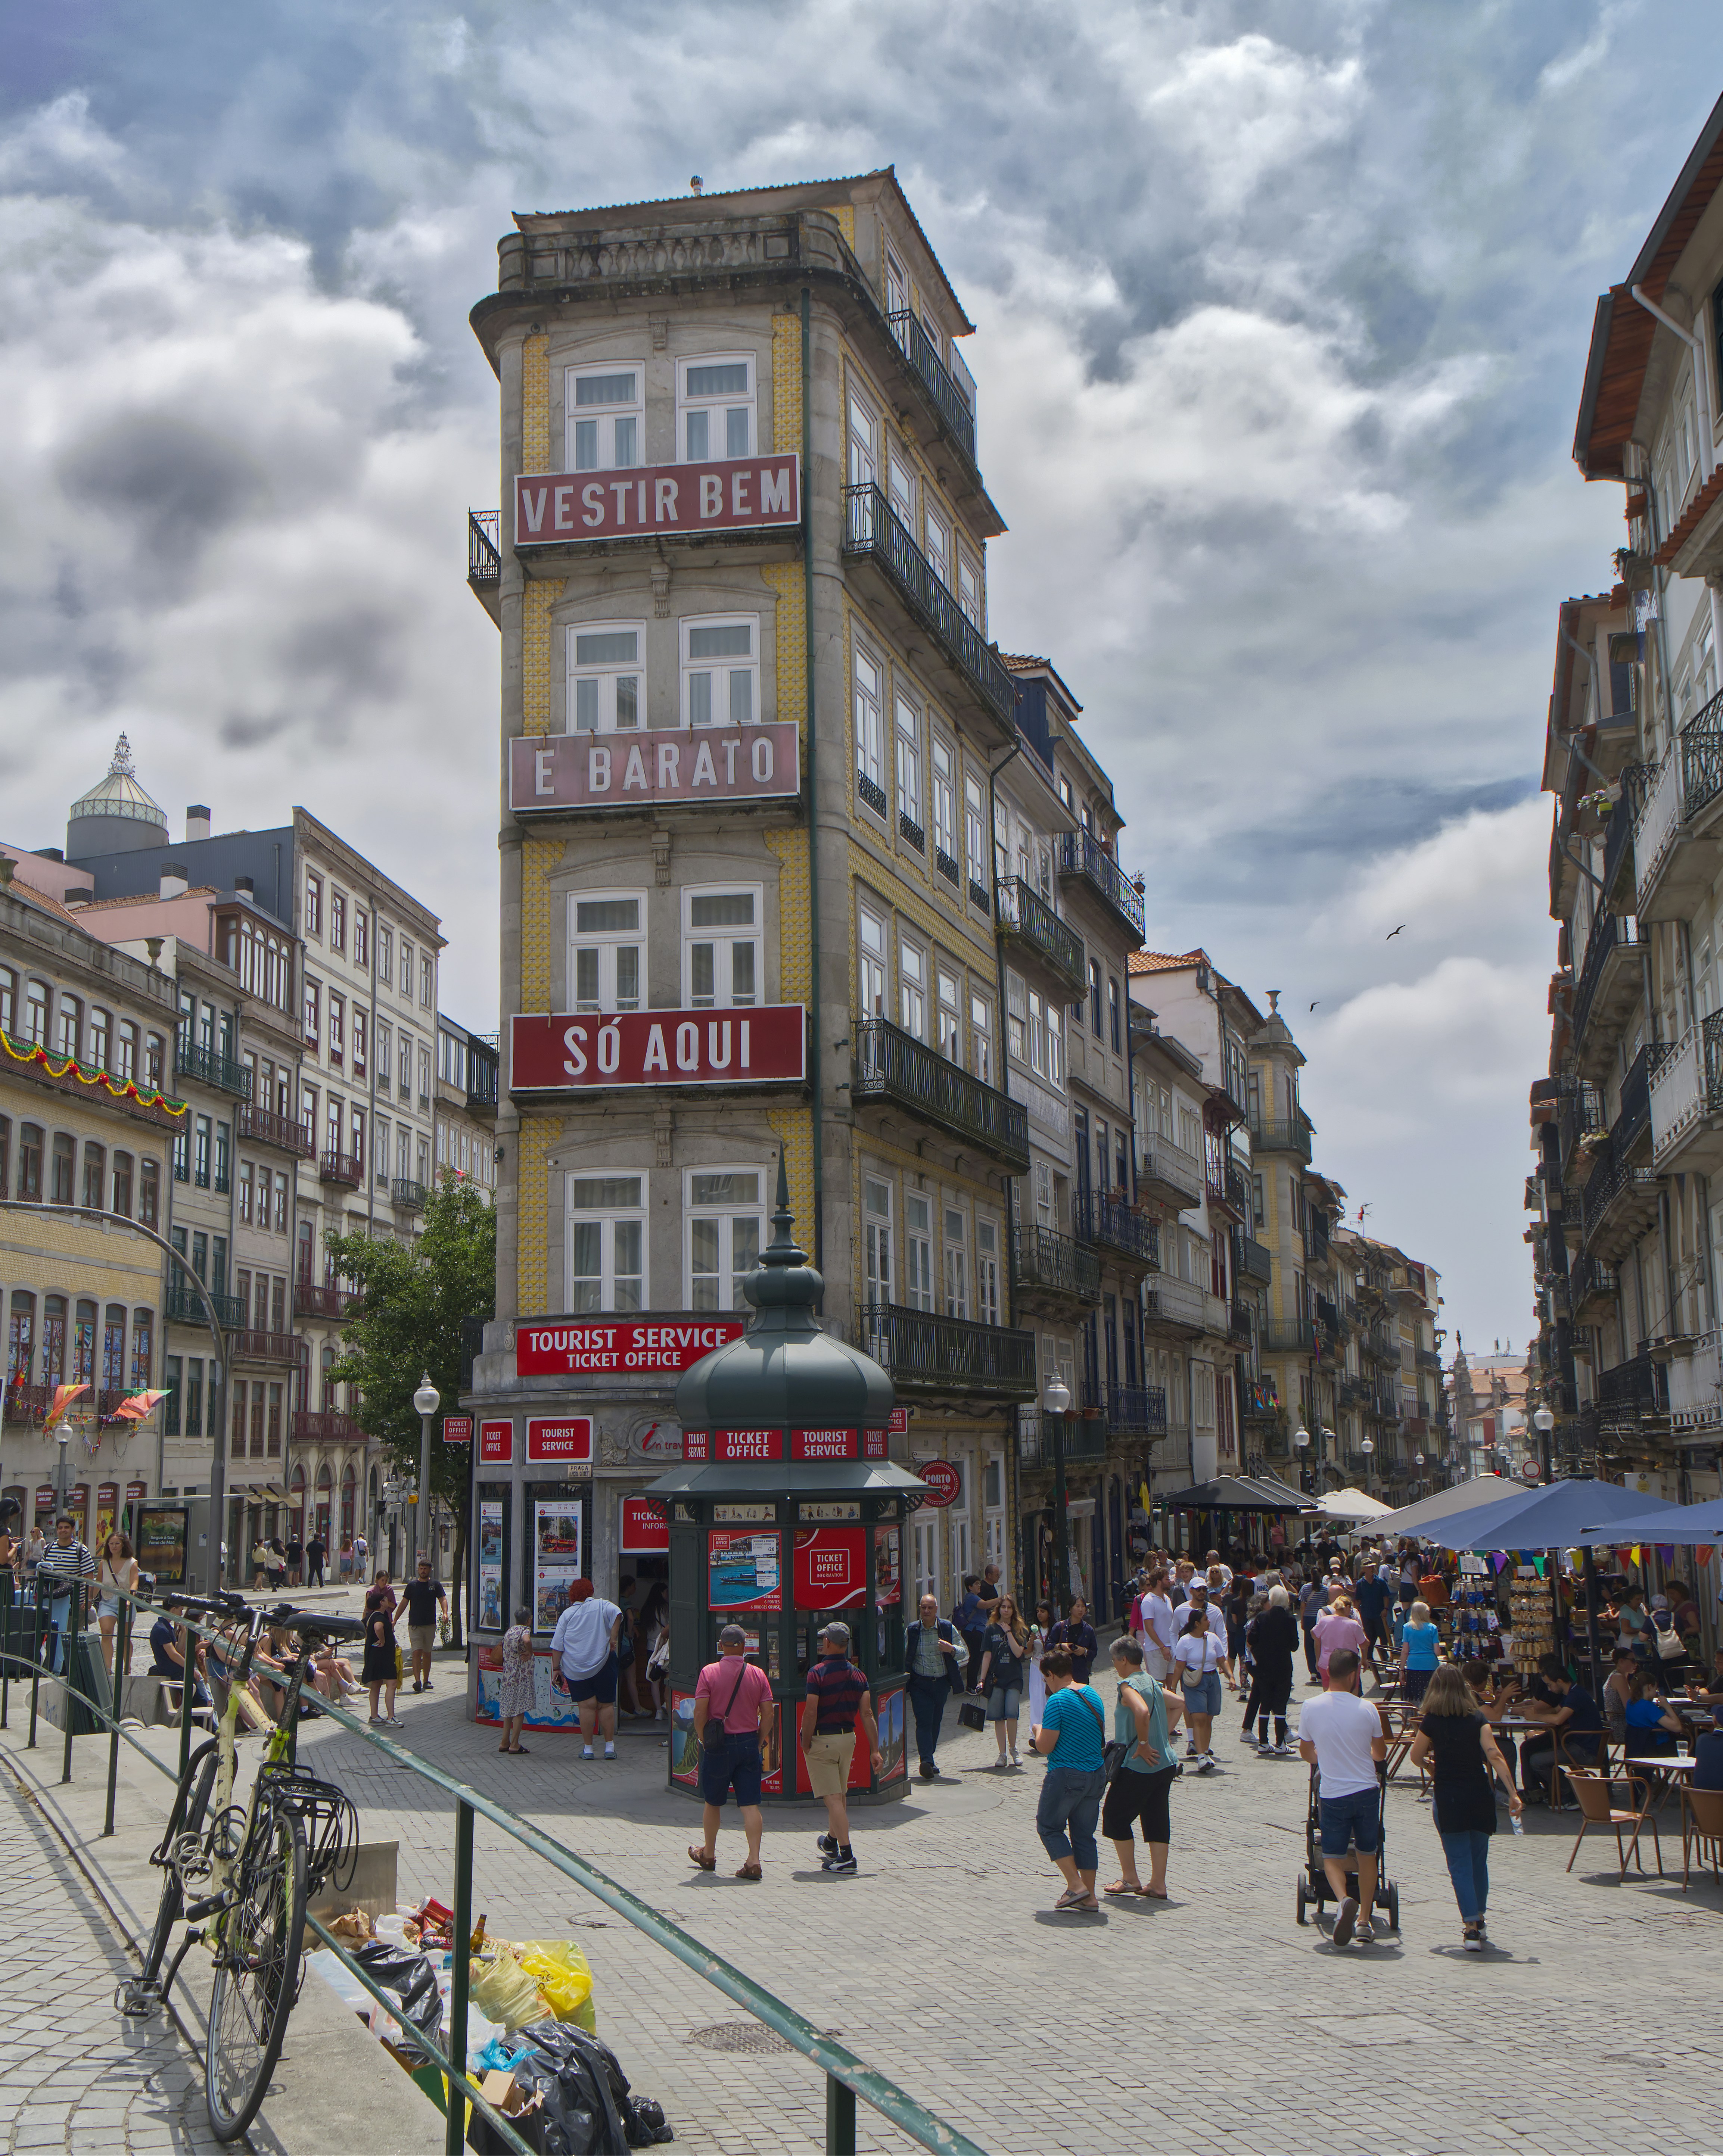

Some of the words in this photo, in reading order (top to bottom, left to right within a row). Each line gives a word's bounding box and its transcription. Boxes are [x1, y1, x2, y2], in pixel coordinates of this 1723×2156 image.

[522, 478, 679, 532] VESTIR
[700, 468, 790, 519] BEM
[535, 749, 555, 795] E
[589, 737, 774, 792] BARATO
[563, 1016, 623, 1075] SÓ
[643, 1020, 750, 1072] AQUI
[529, 1329, 617, 1352] TOURIST
[632, 1328, 727, 1348] SERVICE
[567, 1352, 619, 1368] TICKET
[625, 1352, 681, 1366] OFFICE
[486, 1431, 501, 1440] TICKET
[541, 1428, 575, 1437] TOURIST
[727, 1432, 769, 1444] TICKET
[803, 1431, 847, 1443] TOURIST
[867, 1431, 883, 1442] TICKET
[688, 1433, 706, 1444] TOURIST
[486, 1442, 501, 1452] OFFICE
[541, 1441, 574, 1451] SERVICE
[727, 1445, 769, 1457] OFFICE
[804, 1445, 847, 1456] SERVICE
[867, 1443, 883, 1455] OFFICE
[688, 1446, 705, 1458] SERVICE
[925, 1474, 951, 1483] PORTO
[632, 1512, 662, 1520] TICKE
[817, 1554, 843, 1562] TICKET
